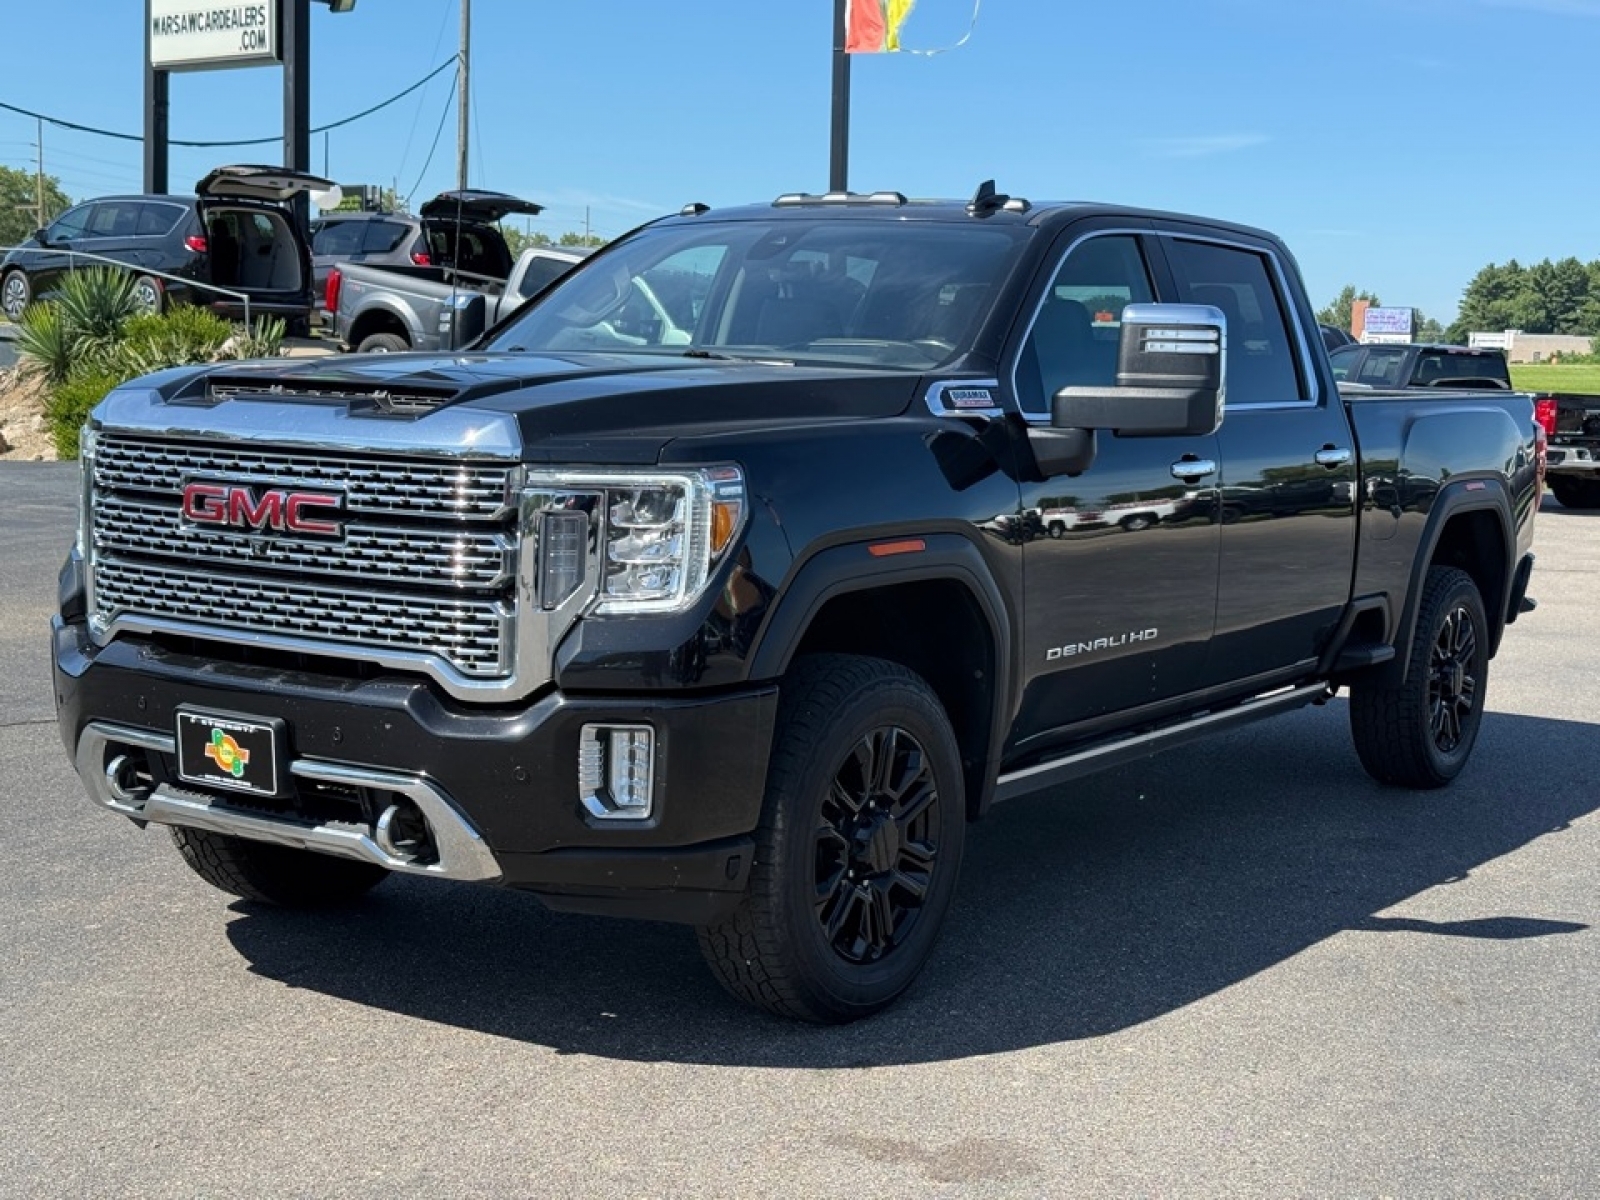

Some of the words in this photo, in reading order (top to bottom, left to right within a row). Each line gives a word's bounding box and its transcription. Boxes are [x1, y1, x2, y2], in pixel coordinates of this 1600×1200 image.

[153, 5, 266, 36] WARSAWCARDEALERS
[239, 29, 266, 51] .COM
[948, 389, 991, 401] DURAMAX
[182, 483, 343, 536] GMC
[1046, 632, 1126, 661] DENALI
[1129, 627, 1158, 643] HD
